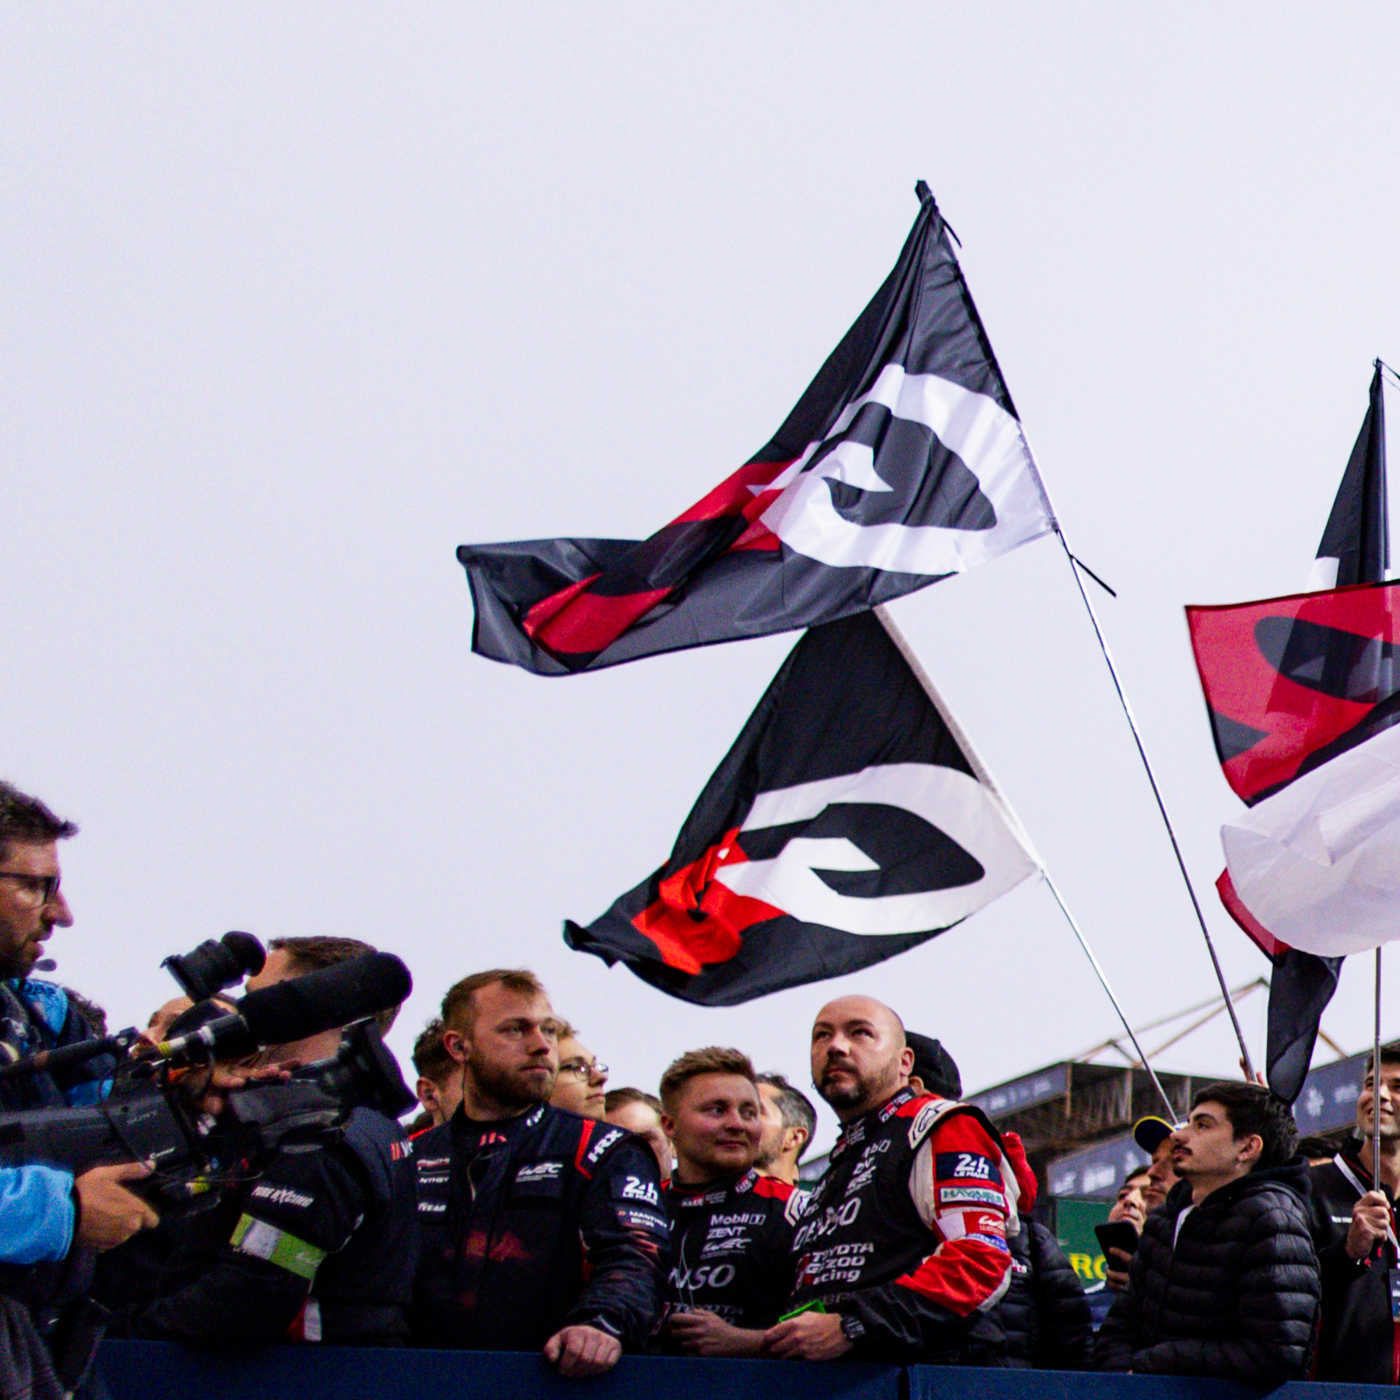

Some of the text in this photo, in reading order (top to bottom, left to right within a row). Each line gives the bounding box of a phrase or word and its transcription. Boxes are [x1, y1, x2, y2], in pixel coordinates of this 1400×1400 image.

[955, 1153, 990, 1174] 24h
[710, 1213, 749, 1226] Mobil
[706, 1226, 746, 1240] ZENT
